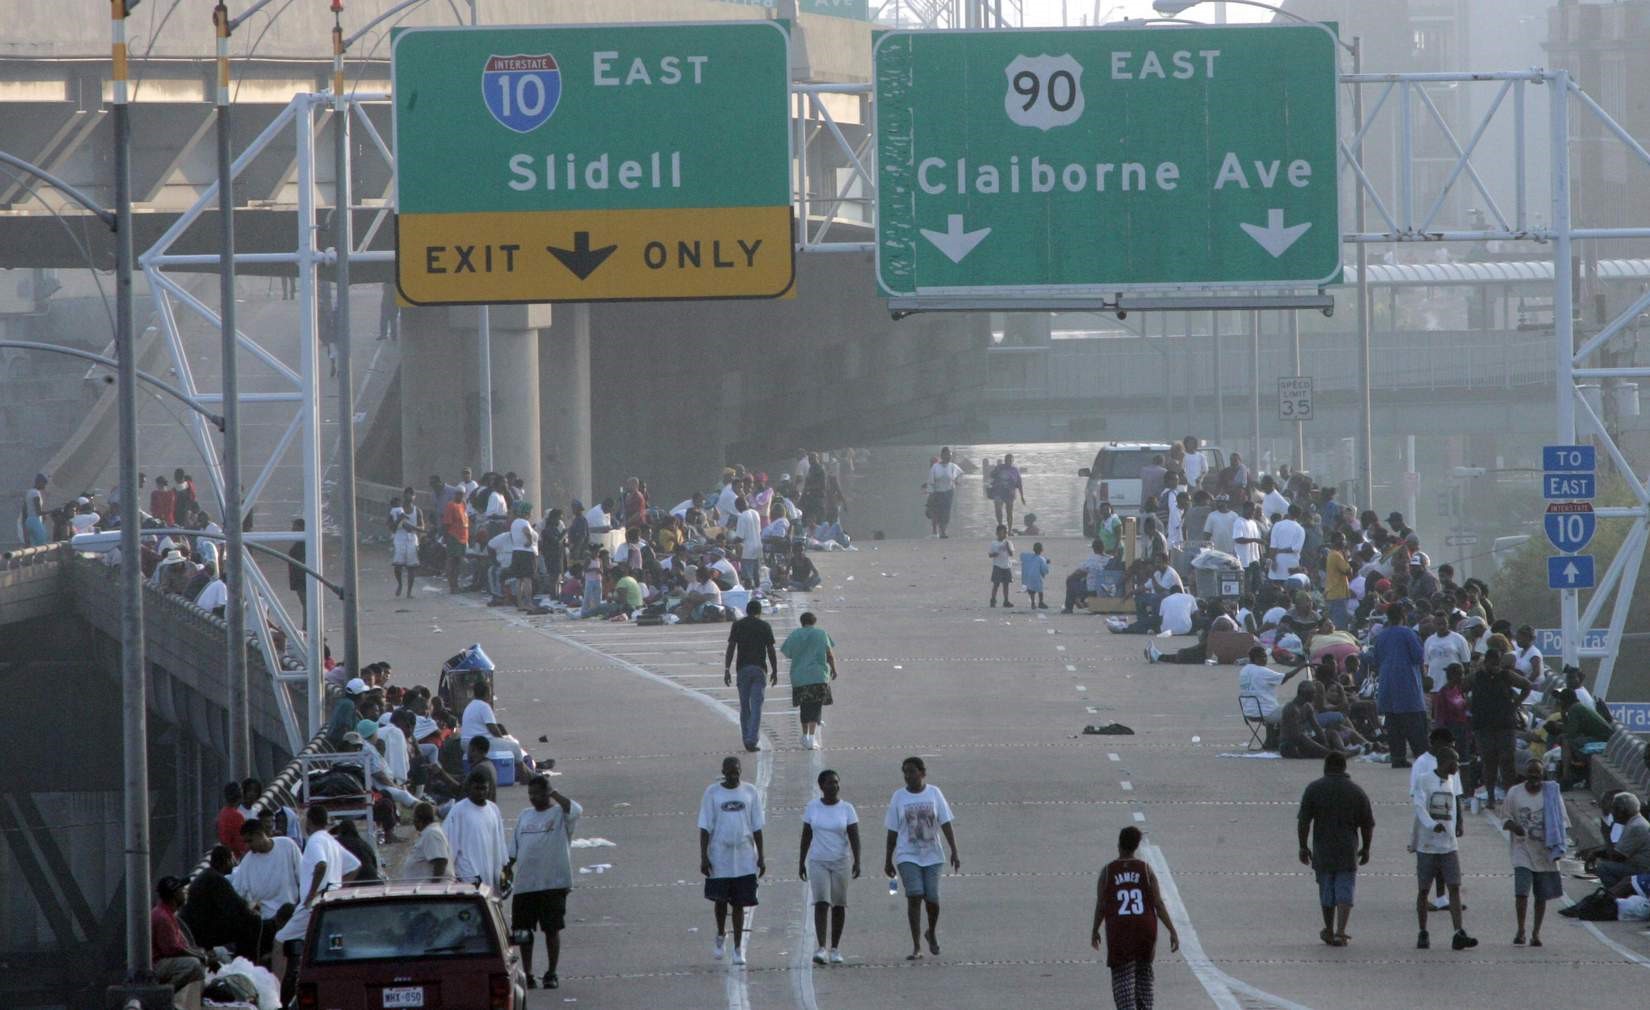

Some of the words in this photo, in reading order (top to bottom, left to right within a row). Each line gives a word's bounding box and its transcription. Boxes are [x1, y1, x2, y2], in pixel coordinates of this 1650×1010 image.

[494, 58, 547, 70] INTERSTATE
[593, 50, 708, 86] EAST
[1111, 49, 1220, 80] EAST
[498, 74, 545, 117] 10
[1013, 70, 1076, 113] 90
[508, 151, 681, 191] Slidell
[917, 155, 1180, 195] Claiborne
[1214, 152, 1312, 189] Ave
[426, 244, 520, 274] EXIT
[644, 239, 762, 270] ONLY
[1282, 399, 1310, 416] 35
[1557, 451, 1582, 466] TO
[1551, 477, 1588, 495] EAST
[1550, 504, 1588, 512] INTERSTATE
[1557, 515, 1584, 543] 10
[1543, 631, 1609, 650] Poras
[1114, 871, 1140, 886] JAMES
[1117, 888, 1144, 915] 23
